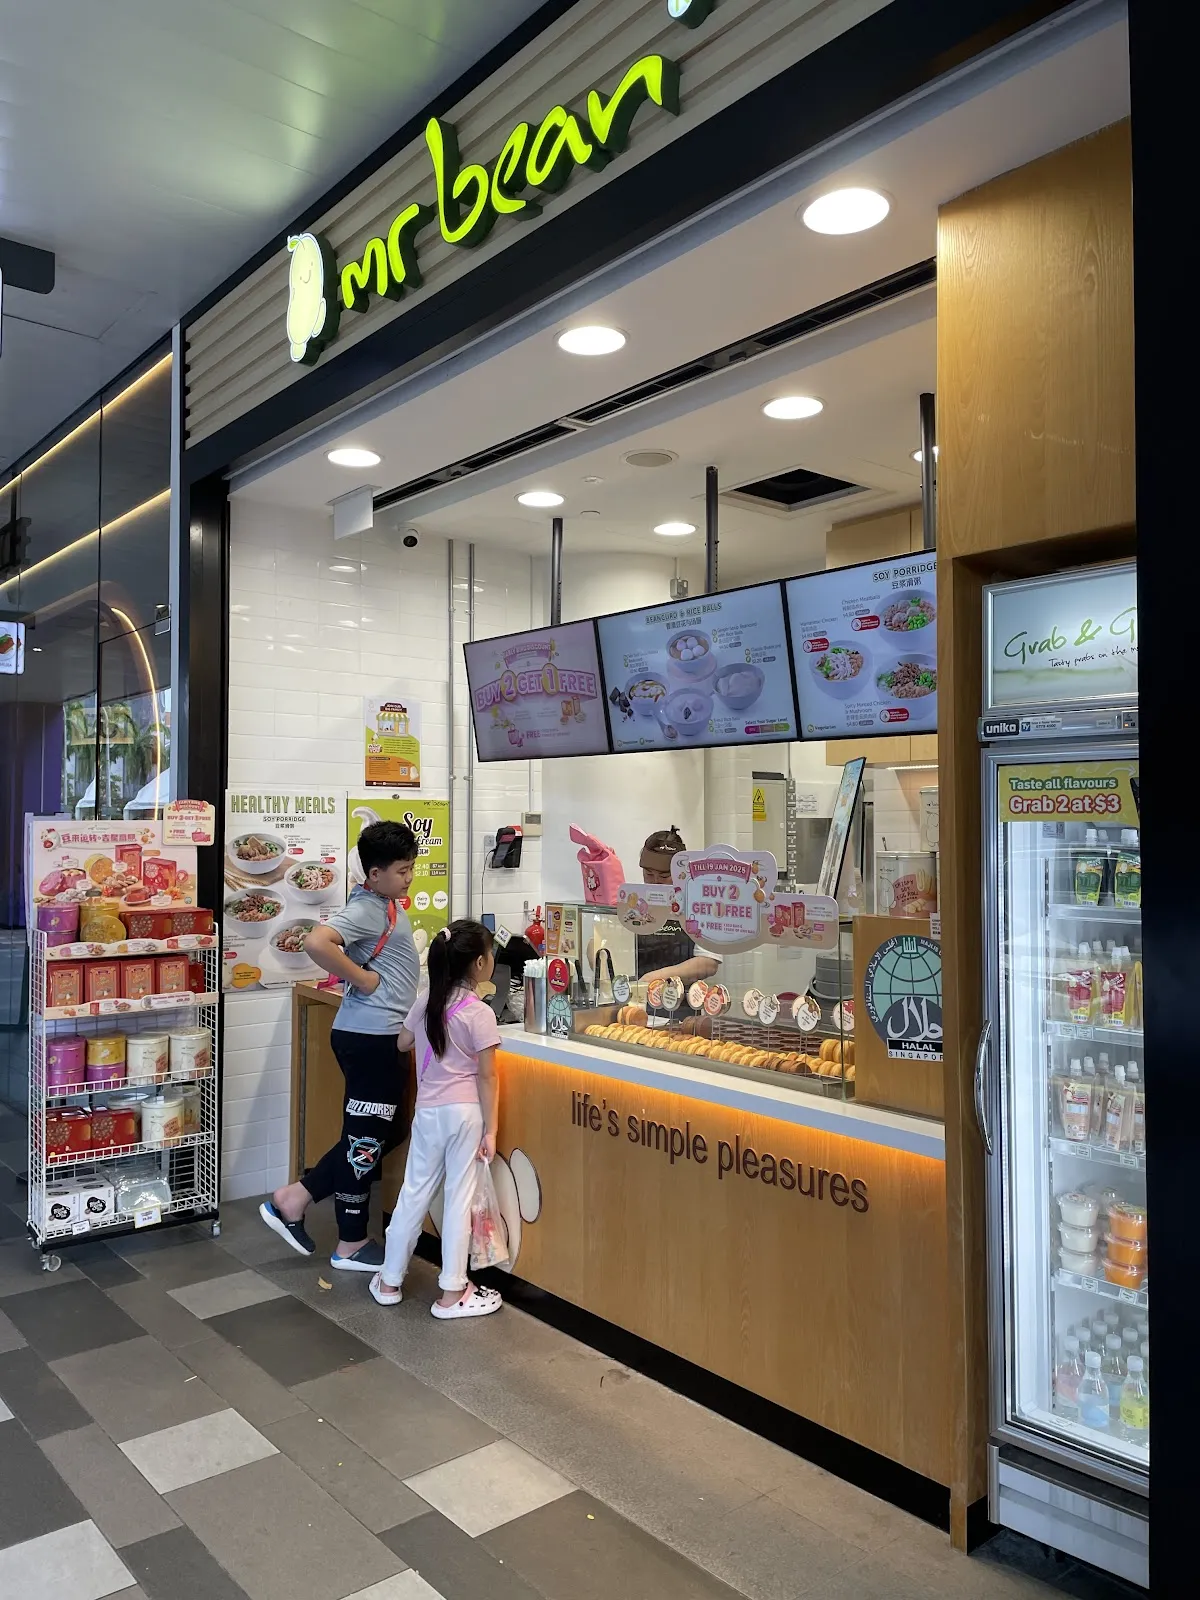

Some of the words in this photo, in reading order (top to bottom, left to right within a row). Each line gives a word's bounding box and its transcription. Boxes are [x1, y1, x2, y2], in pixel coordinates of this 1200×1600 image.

[341, 203, 419, 309] mr
[426, 55, 663, 243] bean
[873, 571, 890, 581] SOY
[686, 606, 701, 616] RICE
[702, 602, 722, 613] BALLS
[1004, 626, 1067, 664] Grab
[1074, 618, 1102, 647] &
[476, 683, 500, 710] BUY
[504, 675, 515, 696] 2
[518, 673, 543, 694] GET
[560, 673, 595, 694] FREE
[1010, 779, 1043, 790] Taste
[1045, 779, 1061, 789] all
[1063, 778, 1117, 789] flavours
[231, 795, 290, 814] HEALTHY
[295, 796, 336, 814] MEALS
[1010, 796, 1055, 813] Grab
[1057, 796, 1069, 812] 2
[1071, 797, 1092, 812] at
[1095, 794, 1120, 813] $3
[403, 812, 433, 838] Soy
[693, 864, 706, 872] TILL
[707, 863, 714, 871] 19
[714, 863, 729, 872] JAN
[729, 865, 746, 874] 2025
[702, 885, 725, 898] BUY
[728, 884, 738, 900] 2
[692, 902, 713, 914] GET
[715, 902, 723, 917] 1
[724, 906, 753, 918] FREE
[706, 922, 723, 931] FREE
[902, 1042, 936, 1052] HALAL
[572, 1090, 620, 1137] life's
[627, 1108, 708, 1165] simple
[717, 1134, 870, 1214] pleasures
